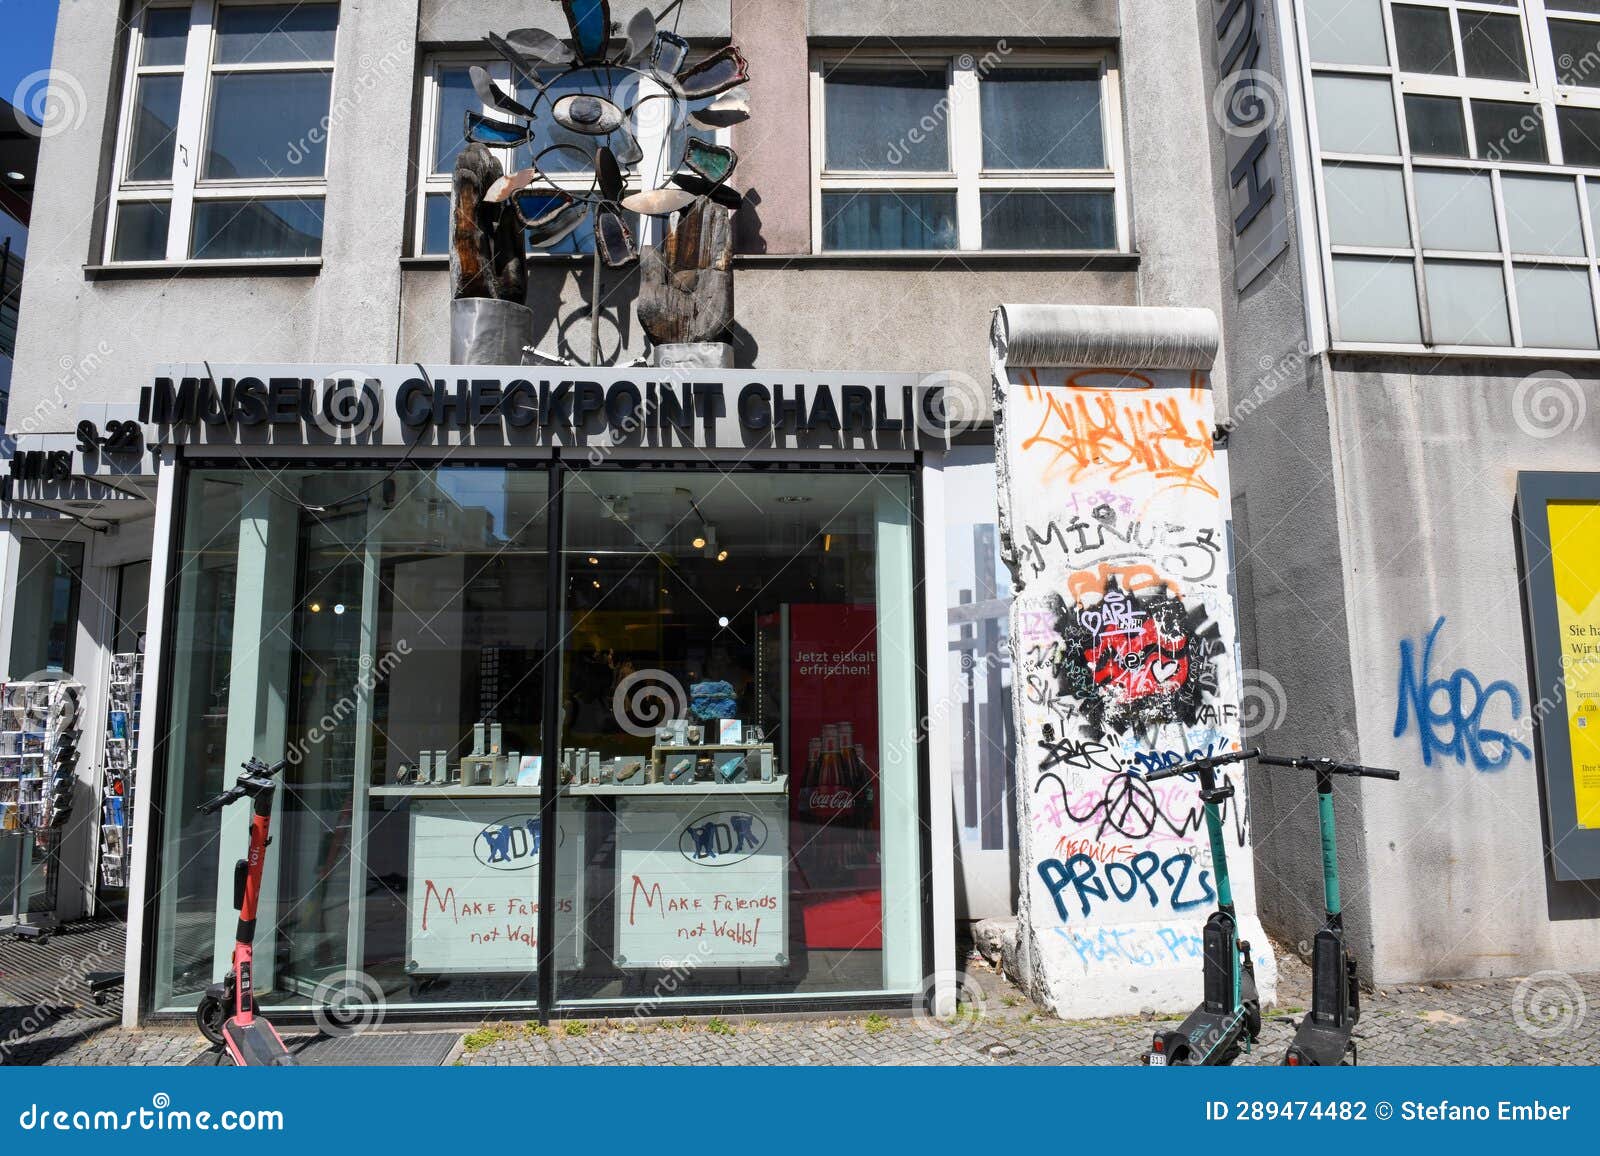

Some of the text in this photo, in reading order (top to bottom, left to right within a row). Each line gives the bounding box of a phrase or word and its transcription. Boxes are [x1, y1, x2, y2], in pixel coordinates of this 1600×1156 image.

[151, 376, 382, 425] MUSEUM
[395, 377, 727, 429] CHECKPOINT
[1569, 625, 1586, 636] Sie
[1572, 643, 1591, 653] Wir
[796, 651, 876, 663] Jetzt eiskalt
[799, 664, 871, 676] erfrischen!
[422, 879, 496, 931] MAKE
[629, 875, 702, 925] MAKE
[471, 927, 500, 944] not
[678, 922, 706, 939] not
